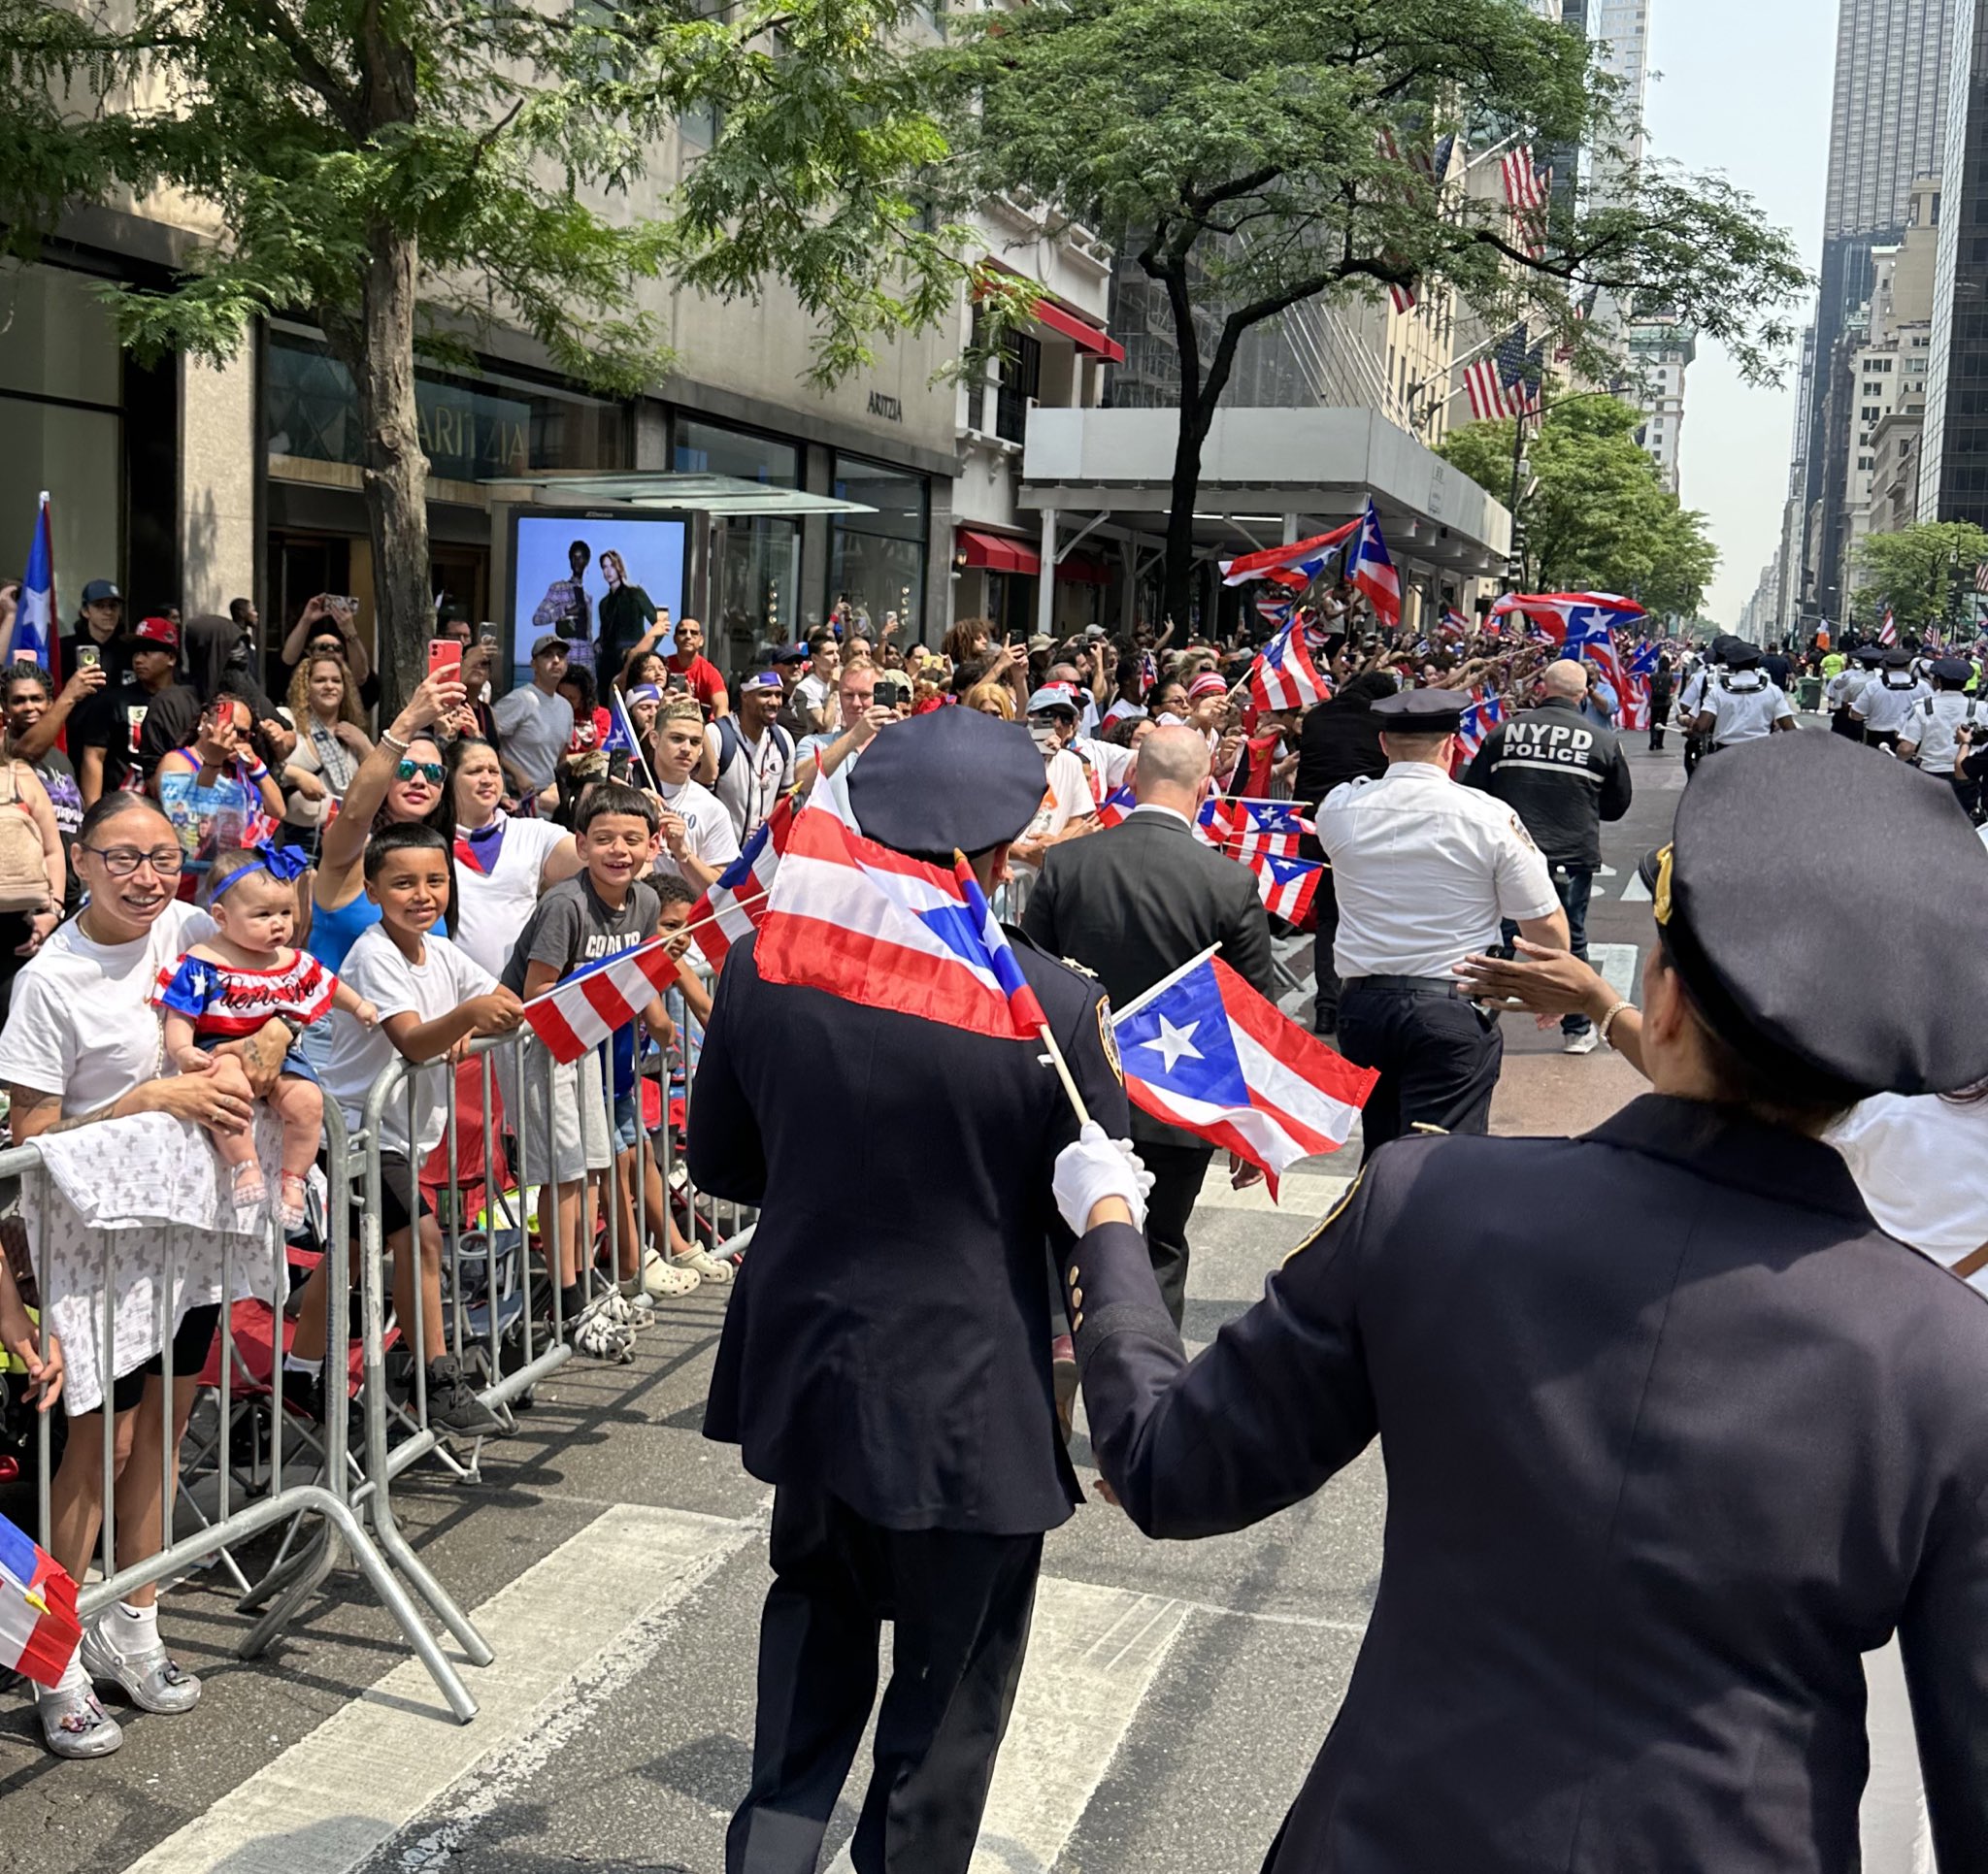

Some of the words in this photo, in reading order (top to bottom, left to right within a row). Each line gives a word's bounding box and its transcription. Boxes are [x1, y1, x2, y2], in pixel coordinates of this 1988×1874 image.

[867, 390, 903, 423] ARITZIA
[1505, 723, 1593, 750] NYPD
[1503, 743, 1589, 765] POLICE
